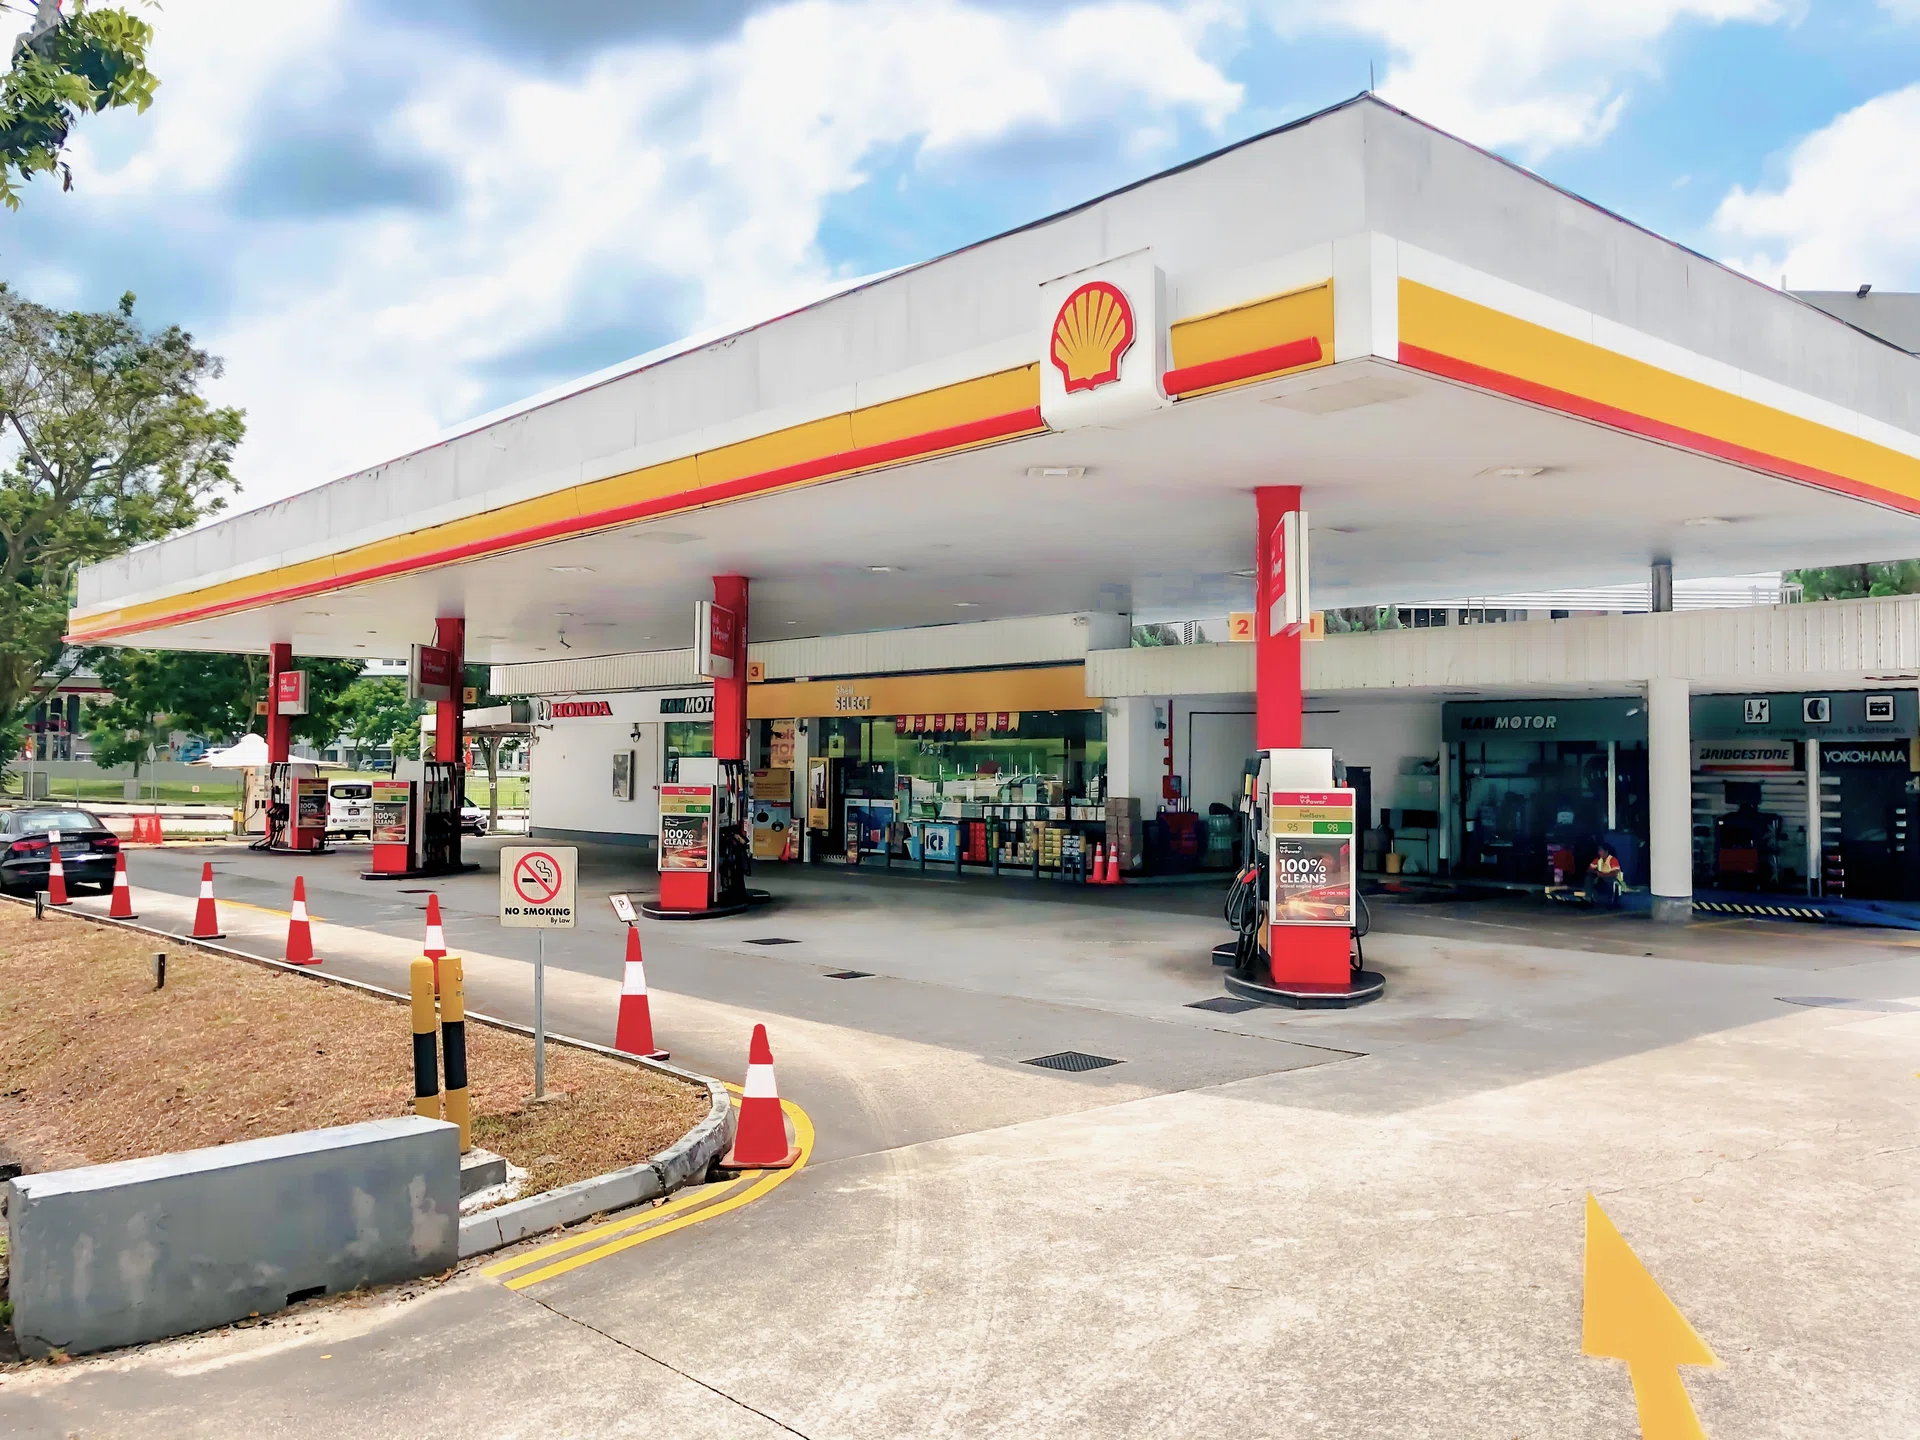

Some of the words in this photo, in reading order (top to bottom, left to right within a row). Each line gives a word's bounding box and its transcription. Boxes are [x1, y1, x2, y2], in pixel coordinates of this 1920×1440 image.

[1237, 619, 1249, 634] 2
[751, 666, 759, 677] 3
[467, 691, 473, 700] 5
[836, 696, 871, 711] SELECT
[551, 701, 613, 718] HONDA
[1816, 726, 1843, 736] Tyres
[1700, 749, 1790, 760] BRIDGESTONE
[1823, 750, 1906, 763] YOKOHAMA
[375, 812, 397, 820] 100%
[1287, 823, 1299, 832] 95
[1327, 824, 1339, 833] 98
[664, 829, 694, 839] 100%
[926, 833, 944, 851] ICE
[1279, 858, 1327, 873] 100%
[1280, 873, 1327, 884] CLEANS
[505, 907, 520, 915] NO
[523, 907, 571, 916] SMOKING
[550, 917, 558, 925] By
